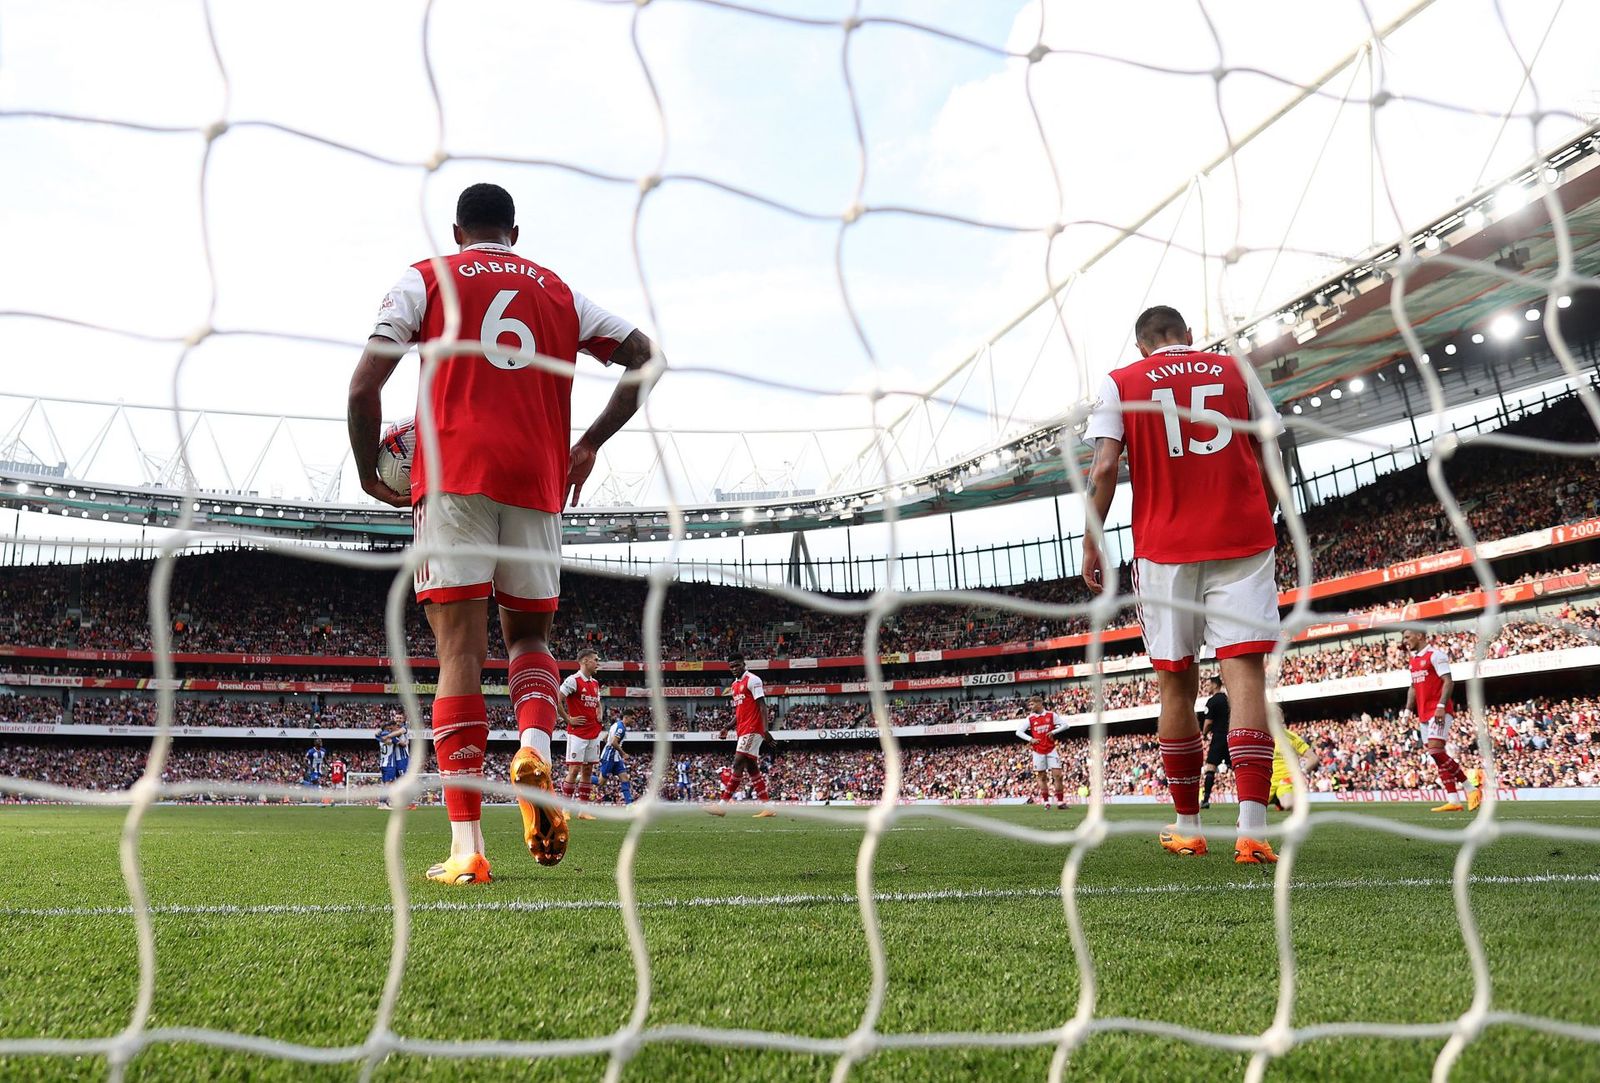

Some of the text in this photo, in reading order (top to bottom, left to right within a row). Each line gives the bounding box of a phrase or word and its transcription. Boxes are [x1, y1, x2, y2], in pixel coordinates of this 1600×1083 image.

[458, 261, 546, 288] GABRIEL
[480, 289, 536, 370] 6
[1145, 361, 1223, 382] KIWIOR
[1151, 383, 1233, 457] 15
[1570, 521, 1600, 538] 2002
[112, 652, 132, 660] 1987
[251, 656, 271, 664] 1989
[972, 673, 1006, 684] SLIGO
[217, 682, 260, 690] Arsenal.com
[784, 686, 826, 694] Arsenal.com
